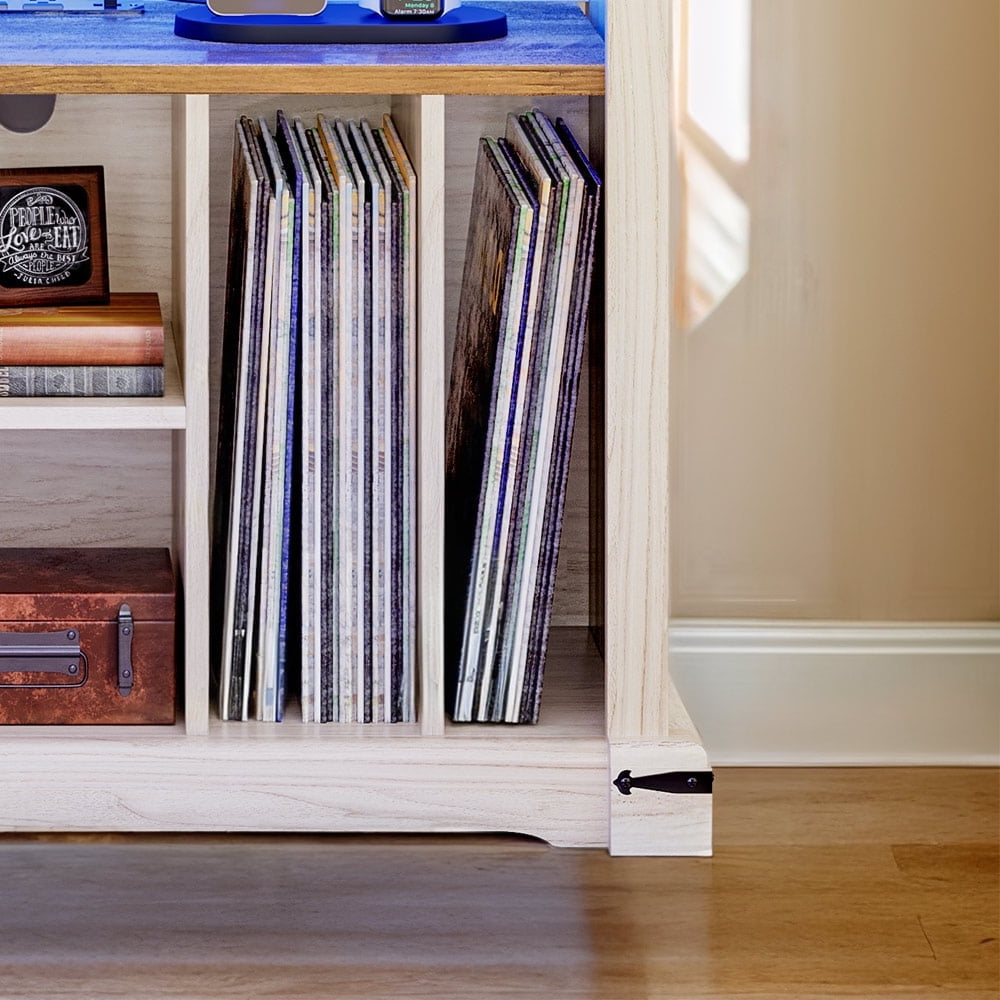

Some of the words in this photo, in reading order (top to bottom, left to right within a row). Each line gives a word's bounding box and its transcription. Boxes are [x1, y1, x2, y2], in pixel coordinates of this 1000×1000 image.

[9, 206, 55, 227] PEOPLE
[53, 226, 80, 249] EAT
[28, 243, 45, 251] ARE
[57, 253, 76, 262] BEST
